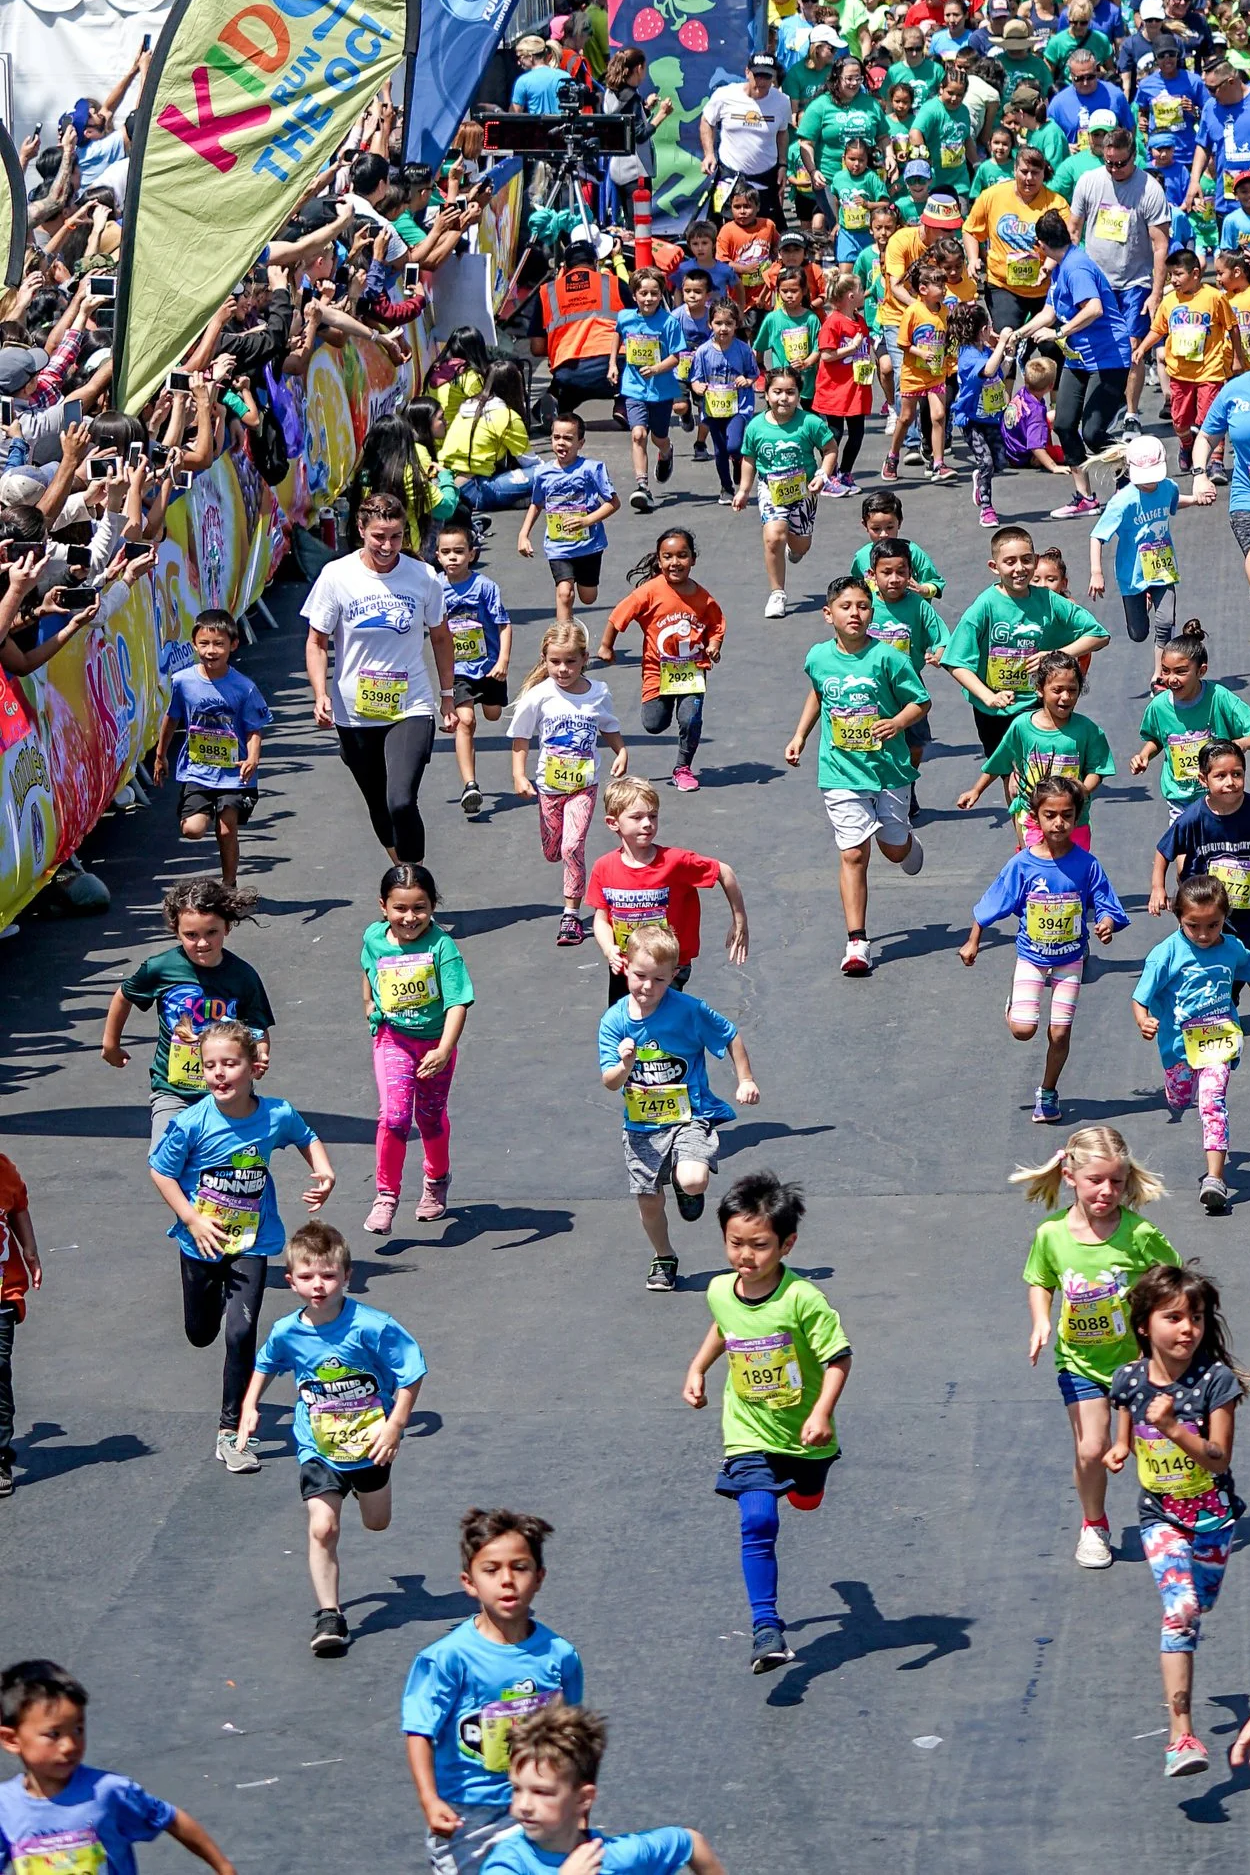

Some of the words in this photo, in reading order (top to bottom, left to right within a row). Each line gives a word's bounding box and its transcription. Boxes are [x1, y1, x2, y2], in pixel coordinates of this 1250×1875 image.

[271, 45, 322, 106] RUN
[252, 92, 335, 183] THE
[323, 14, 393, 94] OC!
[631, 348, 653, 358] 9522
[711, 400, 731, 409] 9793
[778, 483, 800, 497] 3302
[1150, 557, 1174, 571] 1632
[348, 594, 384, 607] MELINDA
[990, 622, 1011, 644] G
[455, 639, 477, 652] 860
[998, 669, 1028, 680] 3346
[823, 676, 841, 701] G
[361, 689, 400, 703] 5398C
[840, 728, 871, 740] 3236
[199, 744, 228, 757] 9883
[553, 769, 584, 783] 5410
[615, 901, 654, 909] ELEMENTARY
[1038, 917, 1071, 931] 3947
[391, 981, 425, 996] 3300
[185, 998, 239, 1020] KIDS
[1198, 1036, 1235, 1053] 5075
[638, 1098, 677, 1113] 7478
[214, 1170, 234, 1179] 2019
[203, 1174, 268, 1195] RUNNERS
[1067, 1315, 1110, 1332] 5088
[742, 1366, 784, 1386] 1897
[327, 1430, 371, 1446] 7382
[1145, 1456, 1196, 1476] 10146
